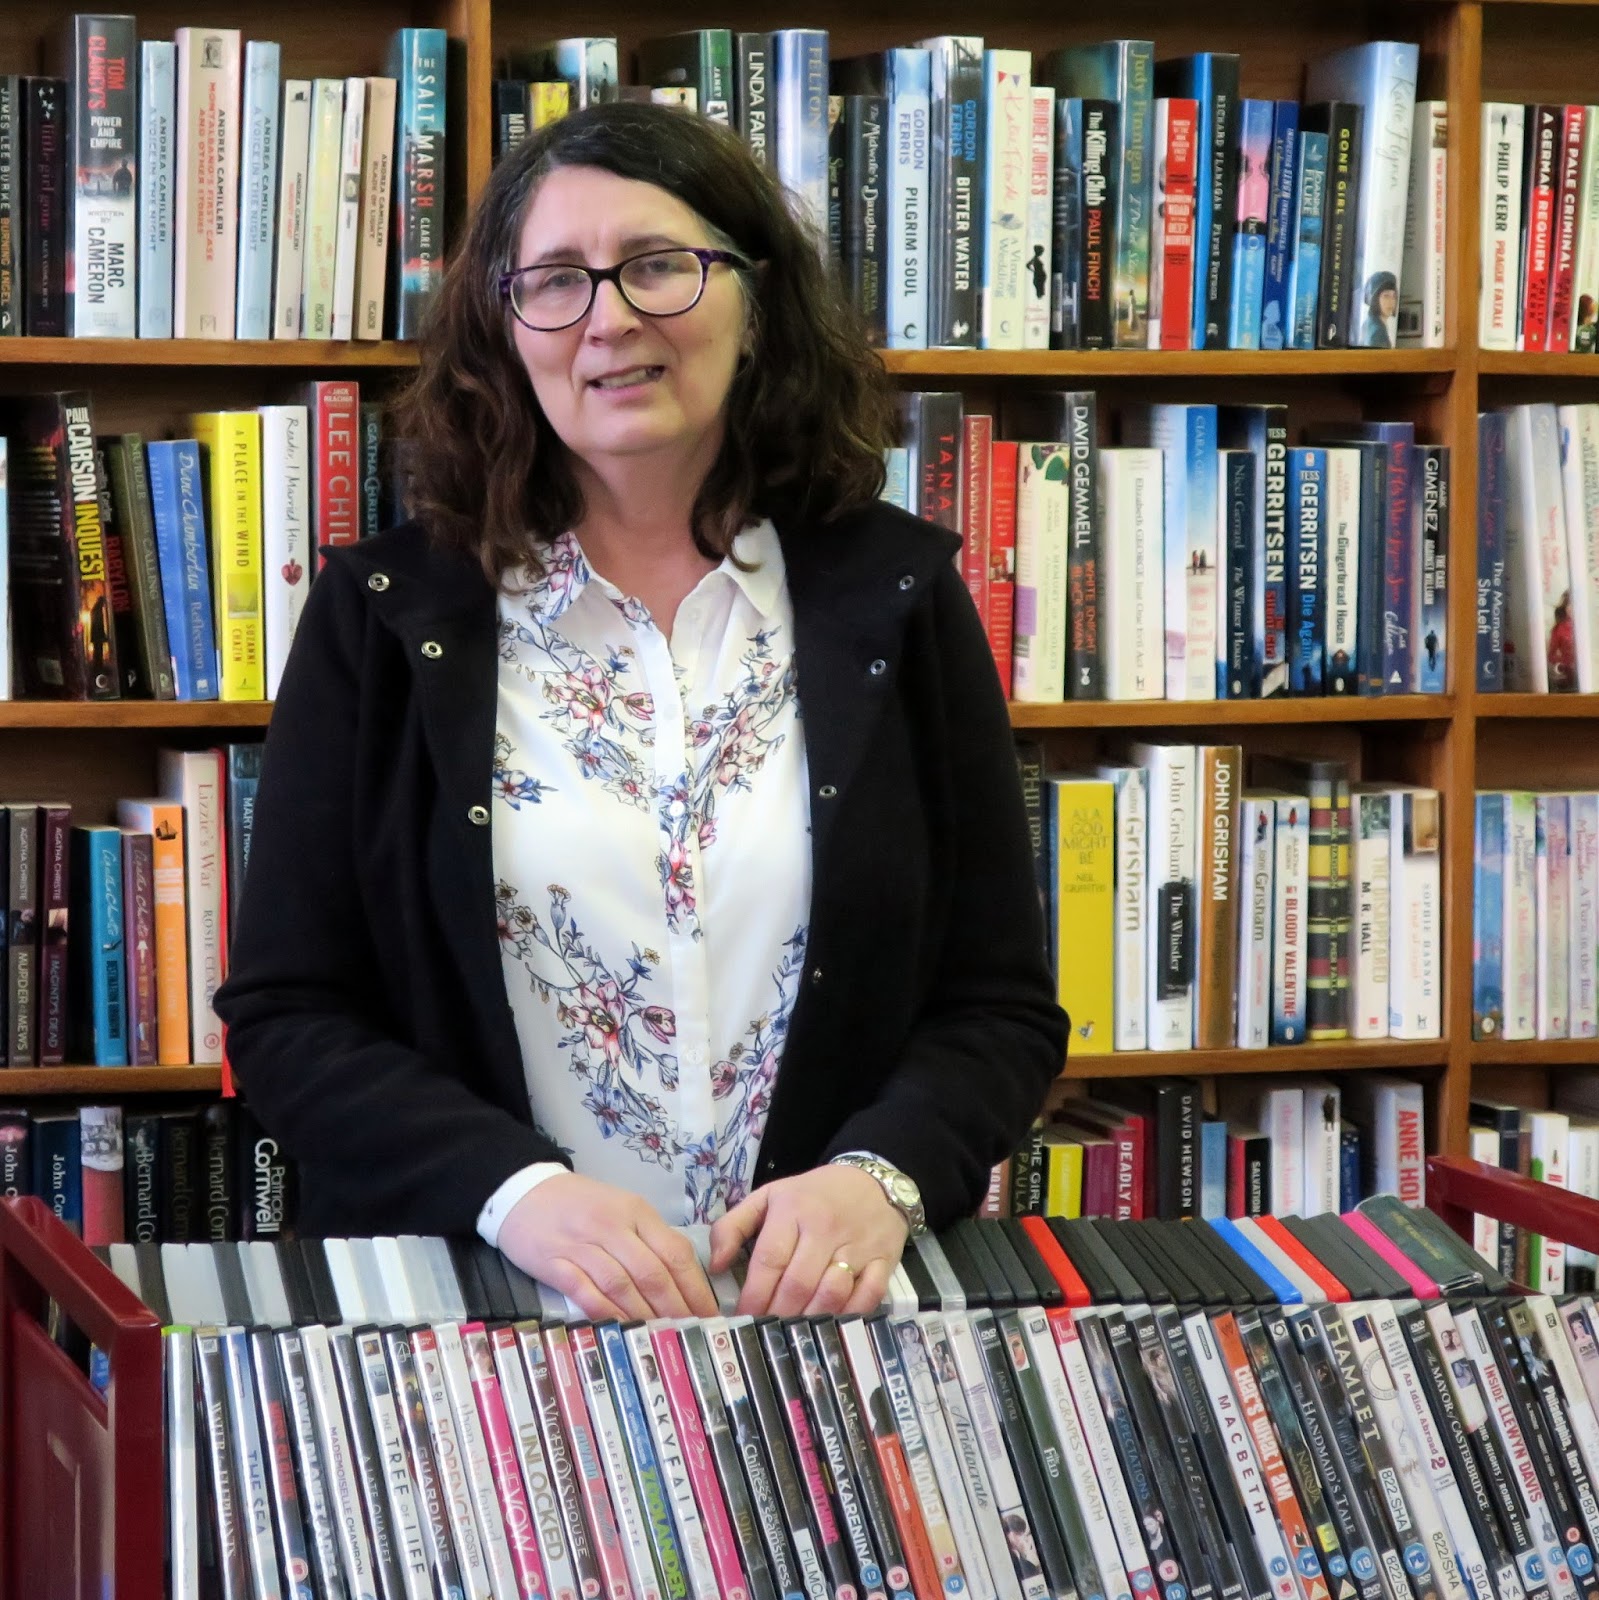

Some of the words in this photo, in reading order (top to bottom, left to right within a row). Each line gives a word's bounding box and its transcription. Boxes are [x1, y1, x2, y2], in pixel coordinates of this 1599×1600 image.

[87, 36, 107, 110] CLANCY'S
[107, 57, 126, 90] TOM
[418, 74, 437, 122] SALT
[712, 66, 722, 98] JANET
[747, 50, 766, 107] LINDA
[1, 87, 11, 130] JAMES
[90, 115, 122, 127] POWER
[97, 127, 116, 138] AND
[950, 103, 964, 157] FERRIS
[963, 99, 977, 162] GORDON
[1031, 97, 1051, 145] BRIDGET
[1088, 110, 1104, 130] The
[1213, 94, 1227, 148] RICHARD
[1542, 111, 1554, 124] A
[1568, 112, 1582, 143] THE
[1, 135, 11, 159] LEE
[89, 138, 122, 149] EMPIRE
[159, 116, 167, 170] ANDREA
[216, 109, 226, 163] ANDREA
[261, 117, 271, 171] ANDREA
[862, 121, 881, 184] Midwife's
[899, 112, 912, 165] FERRIS
[913, 108, 926, 171] GORDON
[1082, 129, 1107, 174] Killing
[1338, 127, 1350, 174] GONE
[378, 154, 388, 194] ANDREA
[416, 134, 435, 208] MARSH
[1031, 146, 1049, 197] JONES'S
[1212, 151, 1225, 211] FLANAGAN
[1495, 141, 1511, 189] PHILIP
[1538, 128, 1553, 196] GERMAN
[1565, 147, 1579, 189] PALE
[0, 165, 11, 211] BURKE
[159, 175, 167, 243] CAMILLERI
[216, 168, 226, 235] CAMILLERI
[259, 174, 270, 243] CAMILLERI
[955, 176, 971, 231] BITTER
[1085, 174, 1106, 207] Club
[1336, 180, 1349, 216] GIRL
[1494, 193, 1509, 232] KERR
[376, 197, 386, 247] CAMILLERI
[419, 217, 433, 248] CLARE
[861, 184, 880, 253] Daughter
[904, 186, 919, 252] PILGRIM
[1087, 209, 1102, 249] PAUL
[1534, 200, 1549, 272] REQUIEM
[1560, 192, 1575, 272] CRIMINAL
[87, 226, 106, 304] CAMERON
[106, 242, 125, 288] MARC
[904, 257, 919, 298] SOUL
[955, 236, 971, 292] WATER
[1087, 251, 1102, 301] FINCH
[1493, 240, 1506, 284] PRAGUE
[66, 407, 89, 422] PAUL
[327, 412, 351, 467] LEE
[1073, 405, 1090, 459] DAVID
[1267, 427, 1286, 439] TESS
[66, 423, 98, 503] CARSON
[177, 451, 196, 498] Diane
[234, 443, 248, 484] PLACE
[924, 463, 936, 494] THE
[939, 433, 954, 512] TANA
[235, 506, 247, 524] THE
[286, 475, 301, 522] Married
[1074, 462, 1091, 549] GEMMELL
[1265, 442, 1286, 582] GERRITSEN
[1423, 457, 1439, 533] GIMENEZ
[1438, 480, 1447, 508] MARK
[74, 502, 105, 581] INQUEST
[180, 498, 205, 591] Chamberlain
[236, 530, 250, 568] WIND
[286, 527, 301, 554] Him
[1299, 481, 1319, 590] GERRITSEN
[1084, 560, 1096, 601] WHITE
[1334, 536, 1350, 606] Gingerbread
[1477, 578, 1491, 606] She
[1492, 560, 1505, 587] The
[1232, 584, 1246, 629] Winter
[1302, 593, 1316, 615] Die
[1336, 609, 1349, 644] House
[1477, 608, 1491, 635] Left
[1491, 590, 1504, 653] Moment
[190, 601, 206, 670] Reflection
[232, 628, 243, 662] CHAZIN
[244, 623, 256, 666] SUZANNE
[1073, 611, 1085, 652] SWAN
[1232, 631, 1246, 671] House
[1300, 620, 1316, 659] Again
[1167, 763, 1186, 804] John
[1213, 758, 1231, 811] JOHN
[242, 797, 254, 832] MARY
[19, 826, 29, 862] AGATHA
[53, 826, 63, 862] AGATHA
[1168, 807, 1186, 879] Grisham
[1212, 813, 1229, 901] GRISHAM
[19, 862, 29, 901] CHRISTIE
[1124, 816, 1144, 932] Grisham
[1170, 893, 1184, 917] The
[1252, 871, 1269, 941] Grisham
[1283, 898, 1298, 946] BLOODY
[1169, 918, 1184, 972] Whistler
[1360, 922, 1372, 956] HALL
[17, 951, 29, 1004] MURDER
[1282, 951, 1298, 1018] VALENTINE
[17, 1014, 29, 1051] MEWS
[1181, 1095, 1193, 1140] DAVID
[1397, 1109, 1420, 1163] ANNE
[52, 1153, 66, 1190] John
[1030, 1135, 1044, 1167] THE
[1118, 1141, 1134, 1201] DEADLY
[1180, 1143, 1193, 1209] HEWSON
[136, 1152, 157, 1219] Bernard
[253, 1137, 280, 1233] Cornwell
[270, 1165, 286, 1222] Patricia
[1014, 1151, 1029, 1214] PAULA
[1029, 1171, 1042, 1211] GIRL
[1251, 1160, 1261, 1213] SALVATION
[1325, 1320, 1382, 1441] HAMLET
[1402, 1372, 1414, 1387] An
[1407, 1389, 1424, 1416] Idiot
[887, 1374, 924, 1452] CERTAIN
[1419, 1417, 1439, 1456] Abroad
[1484, 1363, 1506, 1403] INSIDE
[1497, 1403, 1529, 1461] LLEWYN
[1518, 1462, 1544, 1504] DAVIS
[950, 1405, 991, 1510] Aristocrats
[1058, 1399, 1080, 1451] GRAPES
[1080, 1469, 1105, 1522] WRATH
[1115, 1407, 1150, 1500] EXPECTATIONS
[1218, 1394, 1263, 1515] MACBETH
[1426, 1365, 1454, 1411] MAYOR
[1451, 1420, 1491, 1512] CASTERBRIDGE
[1430, 1456, 1447, 1471] 2
[247, 1449, 261, 1490] THE
[518, 1421, 565, 1561] UNLOCKED
[541, 1396, 576, 1497] VICEROY'S
[565, 1498, 588, 1559] HOUSE
[604, 1430, 641, 1548] SUFFRAGETTE
[742, 1443, 770, 1502] Chinese
[1300, 1400, 1342, 1493] HANDMAID'S
[1338, 1495, 1356, 1535] TALE
[253, 1496, 267, 1536] SEA
[821, 1424, 846, 1477] ANNA
[837, 1478, 874, 1567] KARENINA
[1484, 1442, 1502, 1477] HEIGHTS
[1498, 1482, 1515, 1512] ROMEO
[1511, 1521, 1528, 1547] JULIET
[463, 1528, 480, 1569] FOSTER
